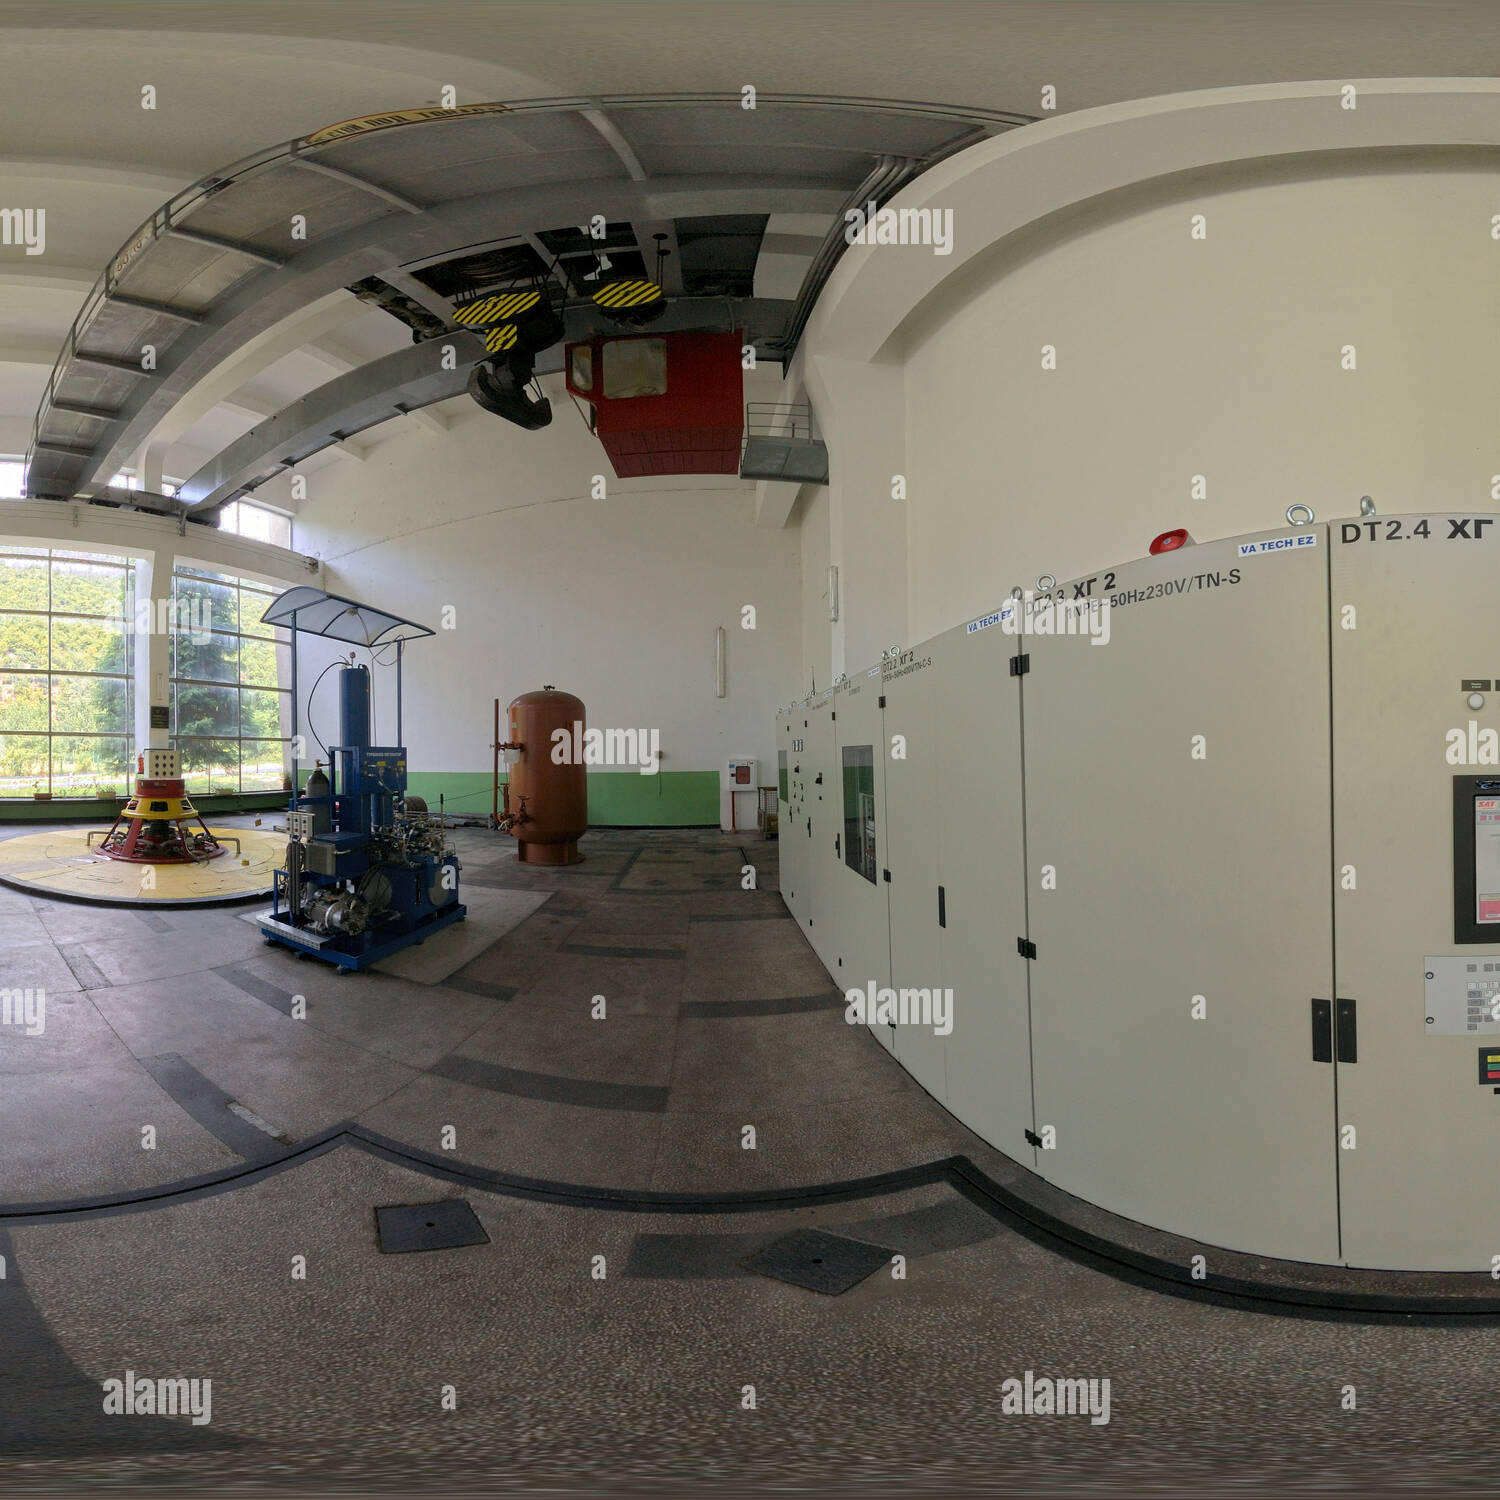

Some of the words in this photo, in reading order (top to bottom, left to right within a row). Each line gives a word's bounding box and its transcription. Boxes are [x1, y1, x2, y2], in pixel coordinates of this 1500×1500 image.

[1341, 519, 1431, 544] DT2.4
[1446, 519, 1493, 539] ХГ
[1241, 544, 1256, 554] VA
[1260, 538, 1293, 551] TECH
[1297, 536, 1314, 546] EZ
[1073, 577, 1097, 600] ХГ
[1103, 572, 1116, 591] 2
[968, 622, 978, 633] VA
[979, 613, 999, 629] TECH
[909, 651, 914, 662] 2
